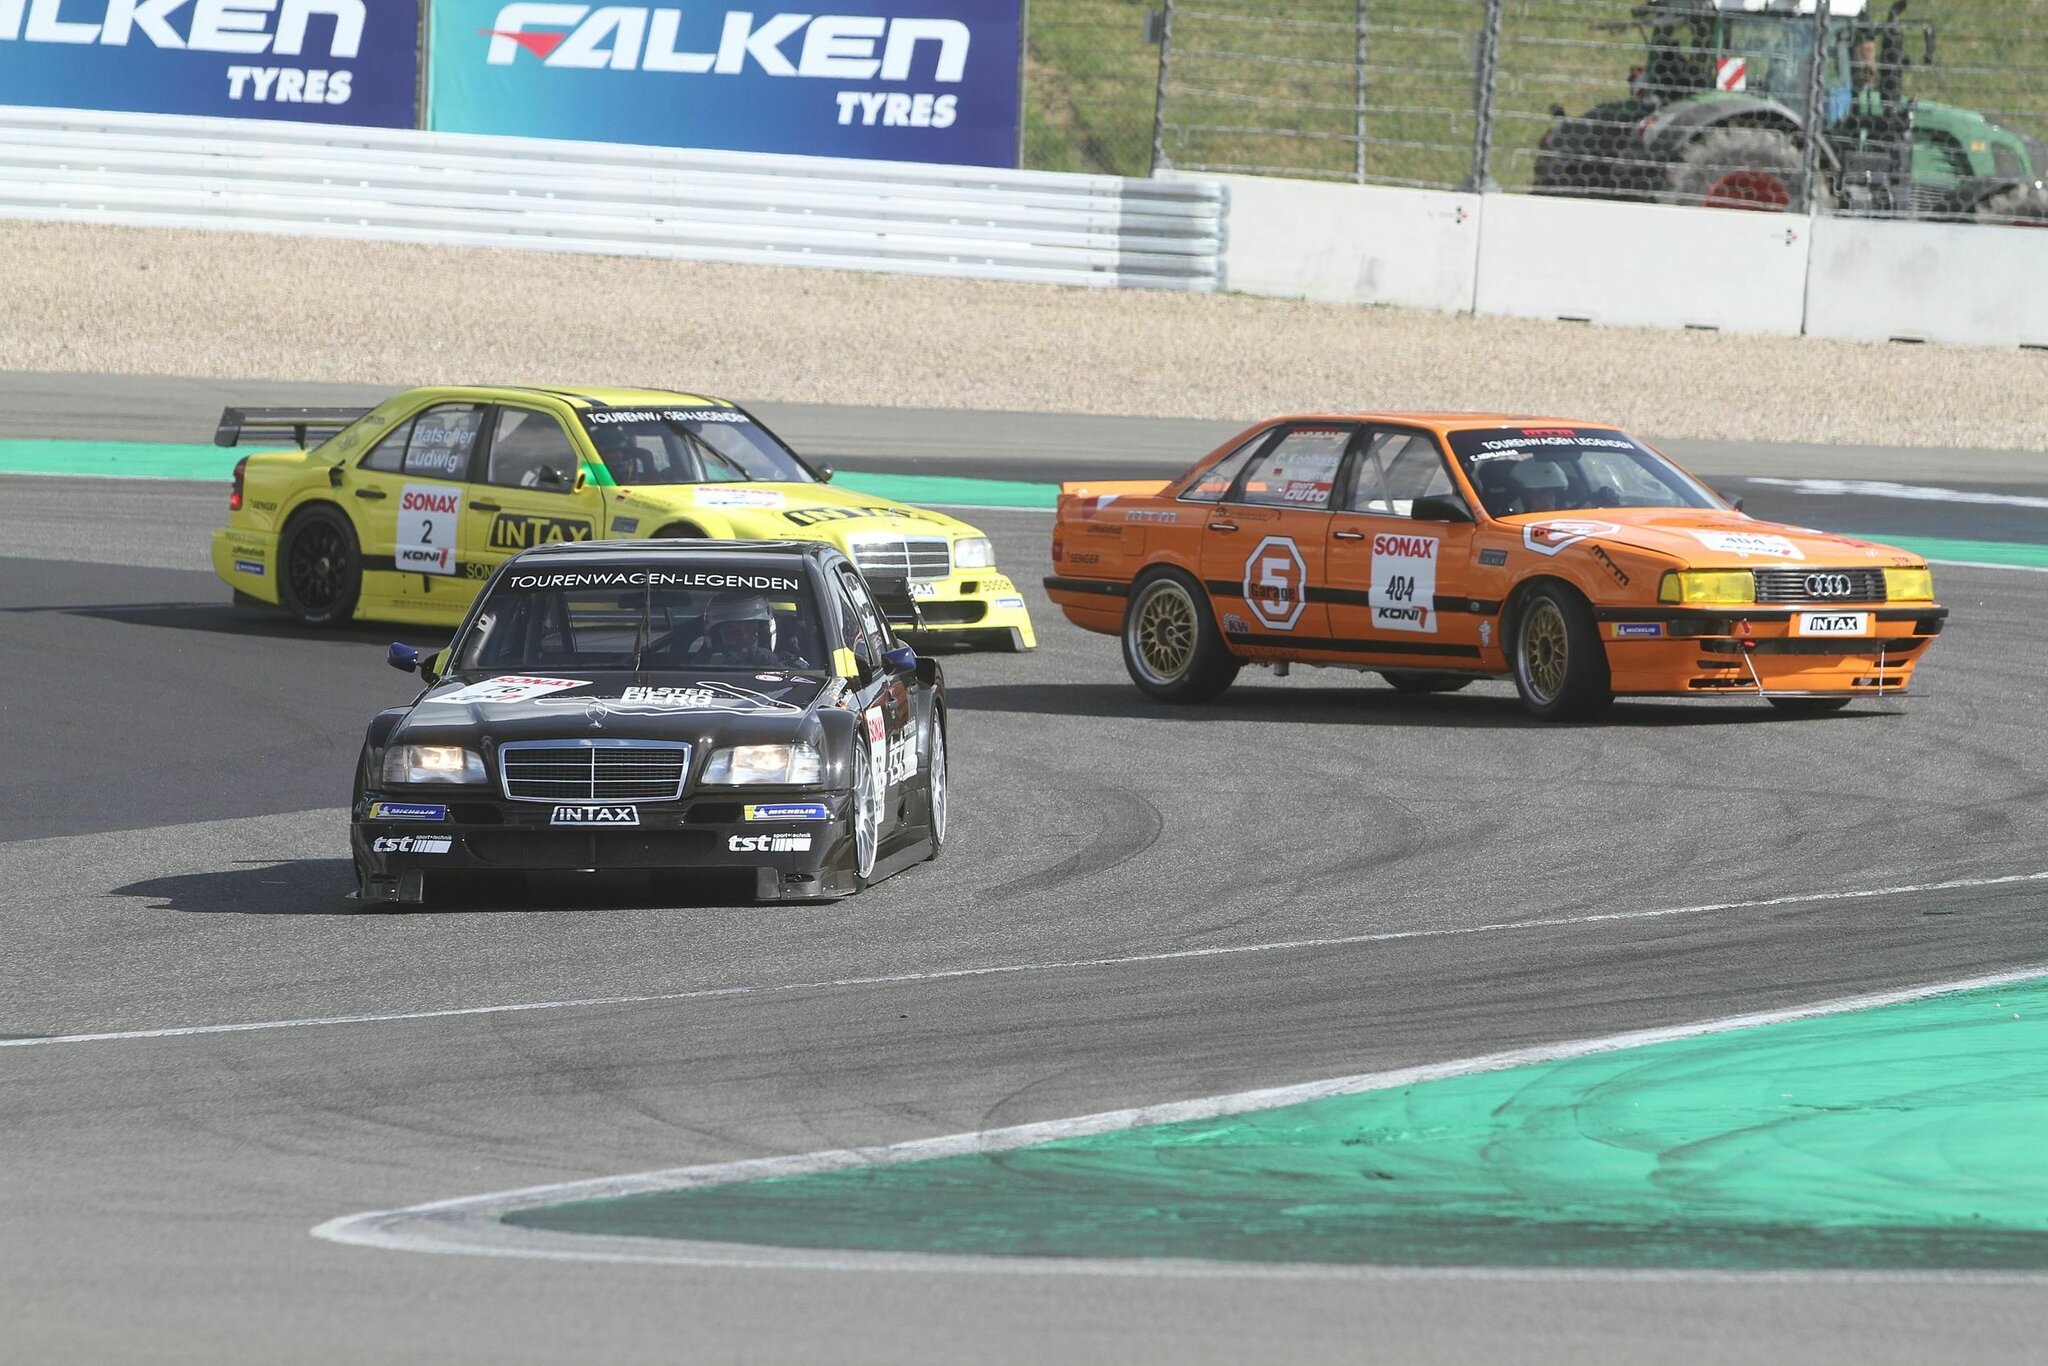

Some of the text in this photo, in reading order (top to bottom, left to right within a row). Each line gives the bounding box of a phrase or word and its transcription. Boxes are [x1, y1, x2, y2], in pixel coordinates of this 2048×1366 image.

[486, 3, 971, 82] FALKEN
[227, 66, 353, 105] TYRES
[836, 91, 958, 129] TYRES
[1482, 437, 1635, 450] TOURENWAGEN LEGENDEN
[405, 448, 458, 473] Ludwig
[402, 492, 458, 513] SONAX
[1283, 489, 1330, 503] auto
[420, 519, 434, 544] 2
[497, 518, 589, 547] INTAX
[402, 549, 440, 562] KONI
[1374, 536, 1433, 558] SONAX
[511, 573, 799, 590] TOURENWAGEN-LEGENDEN
[1261, 557, 1290, 615] 5
[1385, 575, 1414, 602] 404
[1250, 582, 1296, 602] Garage
[1378, 608, 1420, 621] KONI
[1812, 617, 1857, 631] INTAX
[623, 686, 715, 697] BILSTER
[559, 806, 632, 821] INTAX
[373, 836, 414, 852] tst
[728, 835, 772, 851] tst
